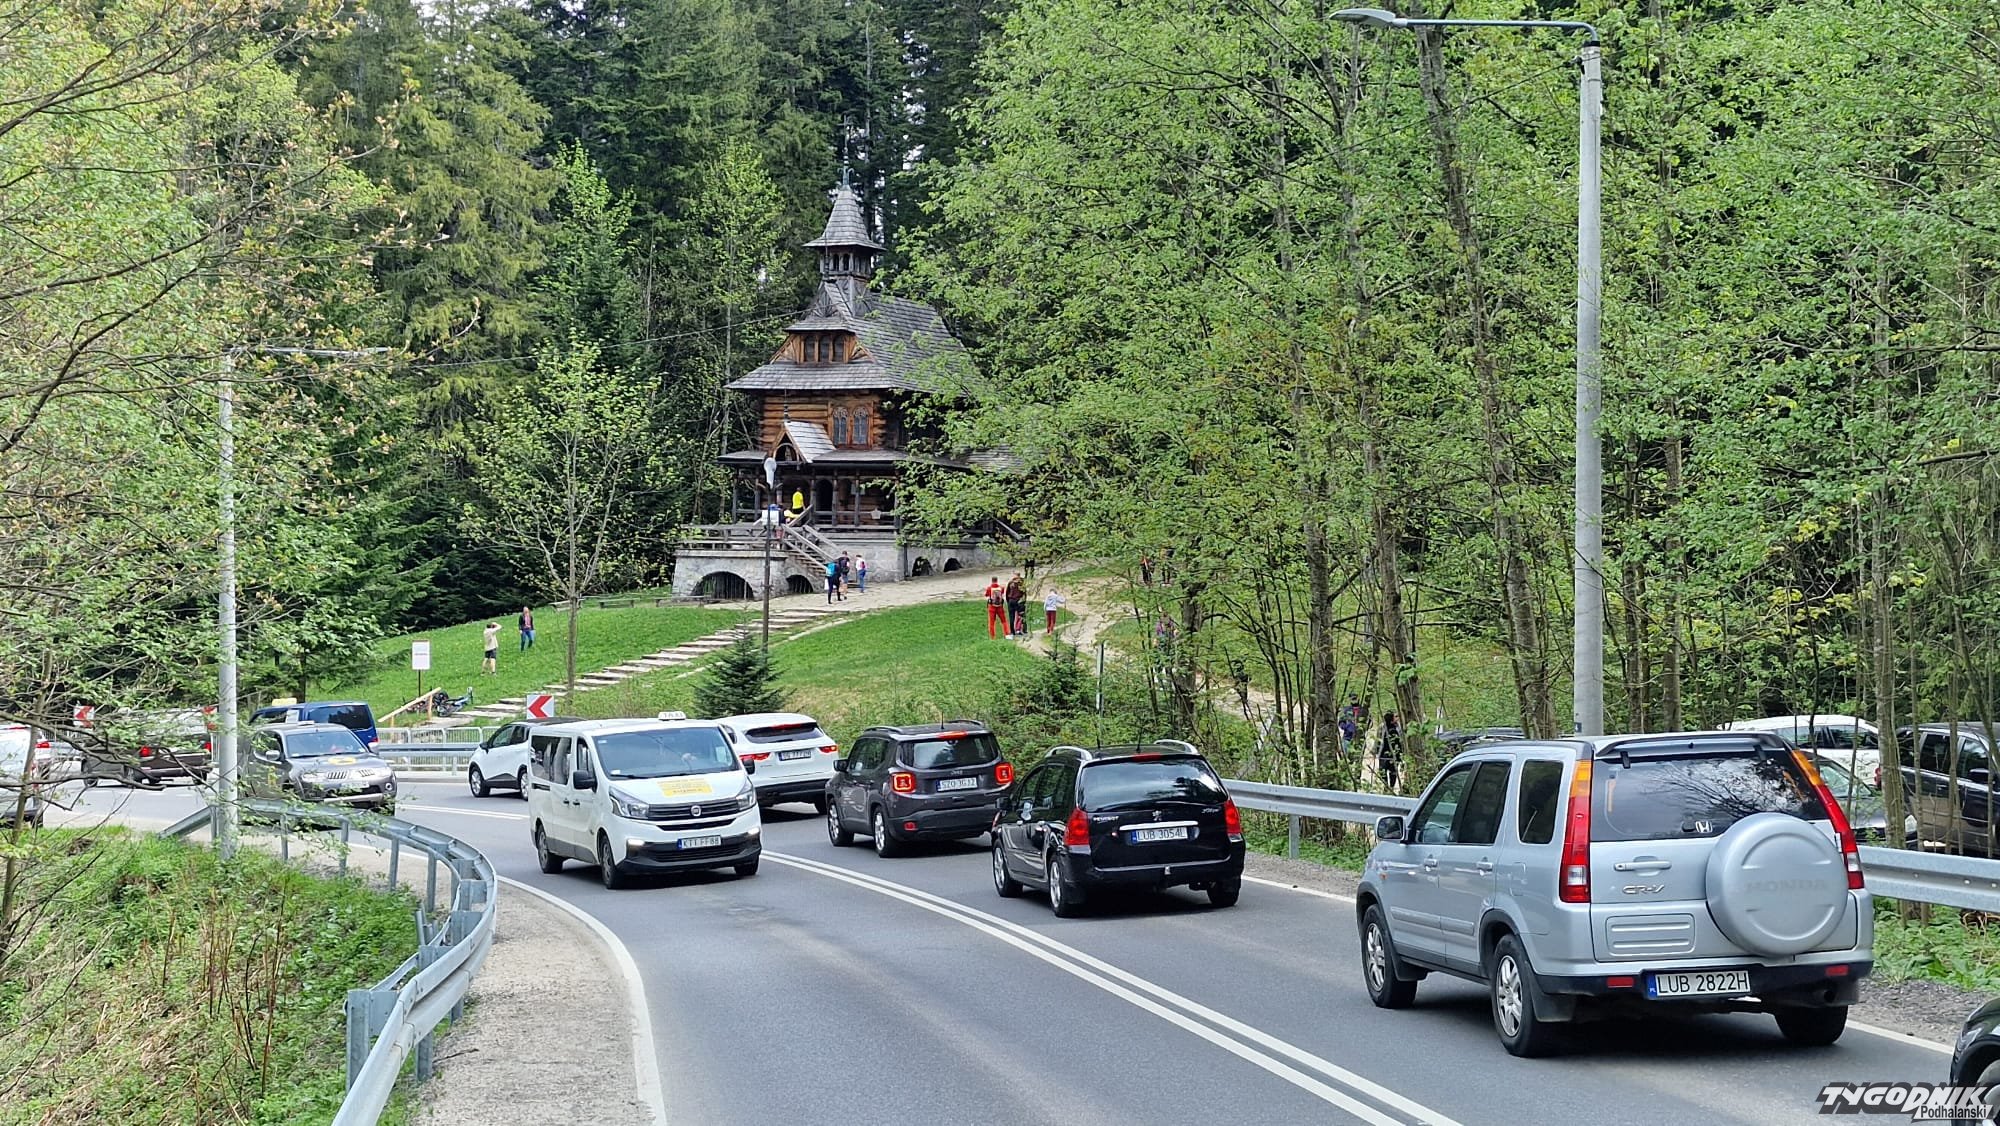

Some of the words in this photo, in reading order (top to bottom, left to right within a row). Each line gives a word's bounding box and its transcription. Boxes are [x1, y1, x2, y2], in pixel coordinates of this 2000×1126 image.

[1137, 829, 1156, 841] LUB
[1159, 826, 1186, 840] 3054L
[1622, 884, 1665, 895] CR-V
[1746, 879, 1828, 892] HONDA
[1657, 974, 1691, 994] LUB
[1695, 971, 1749, 992] 2822H
